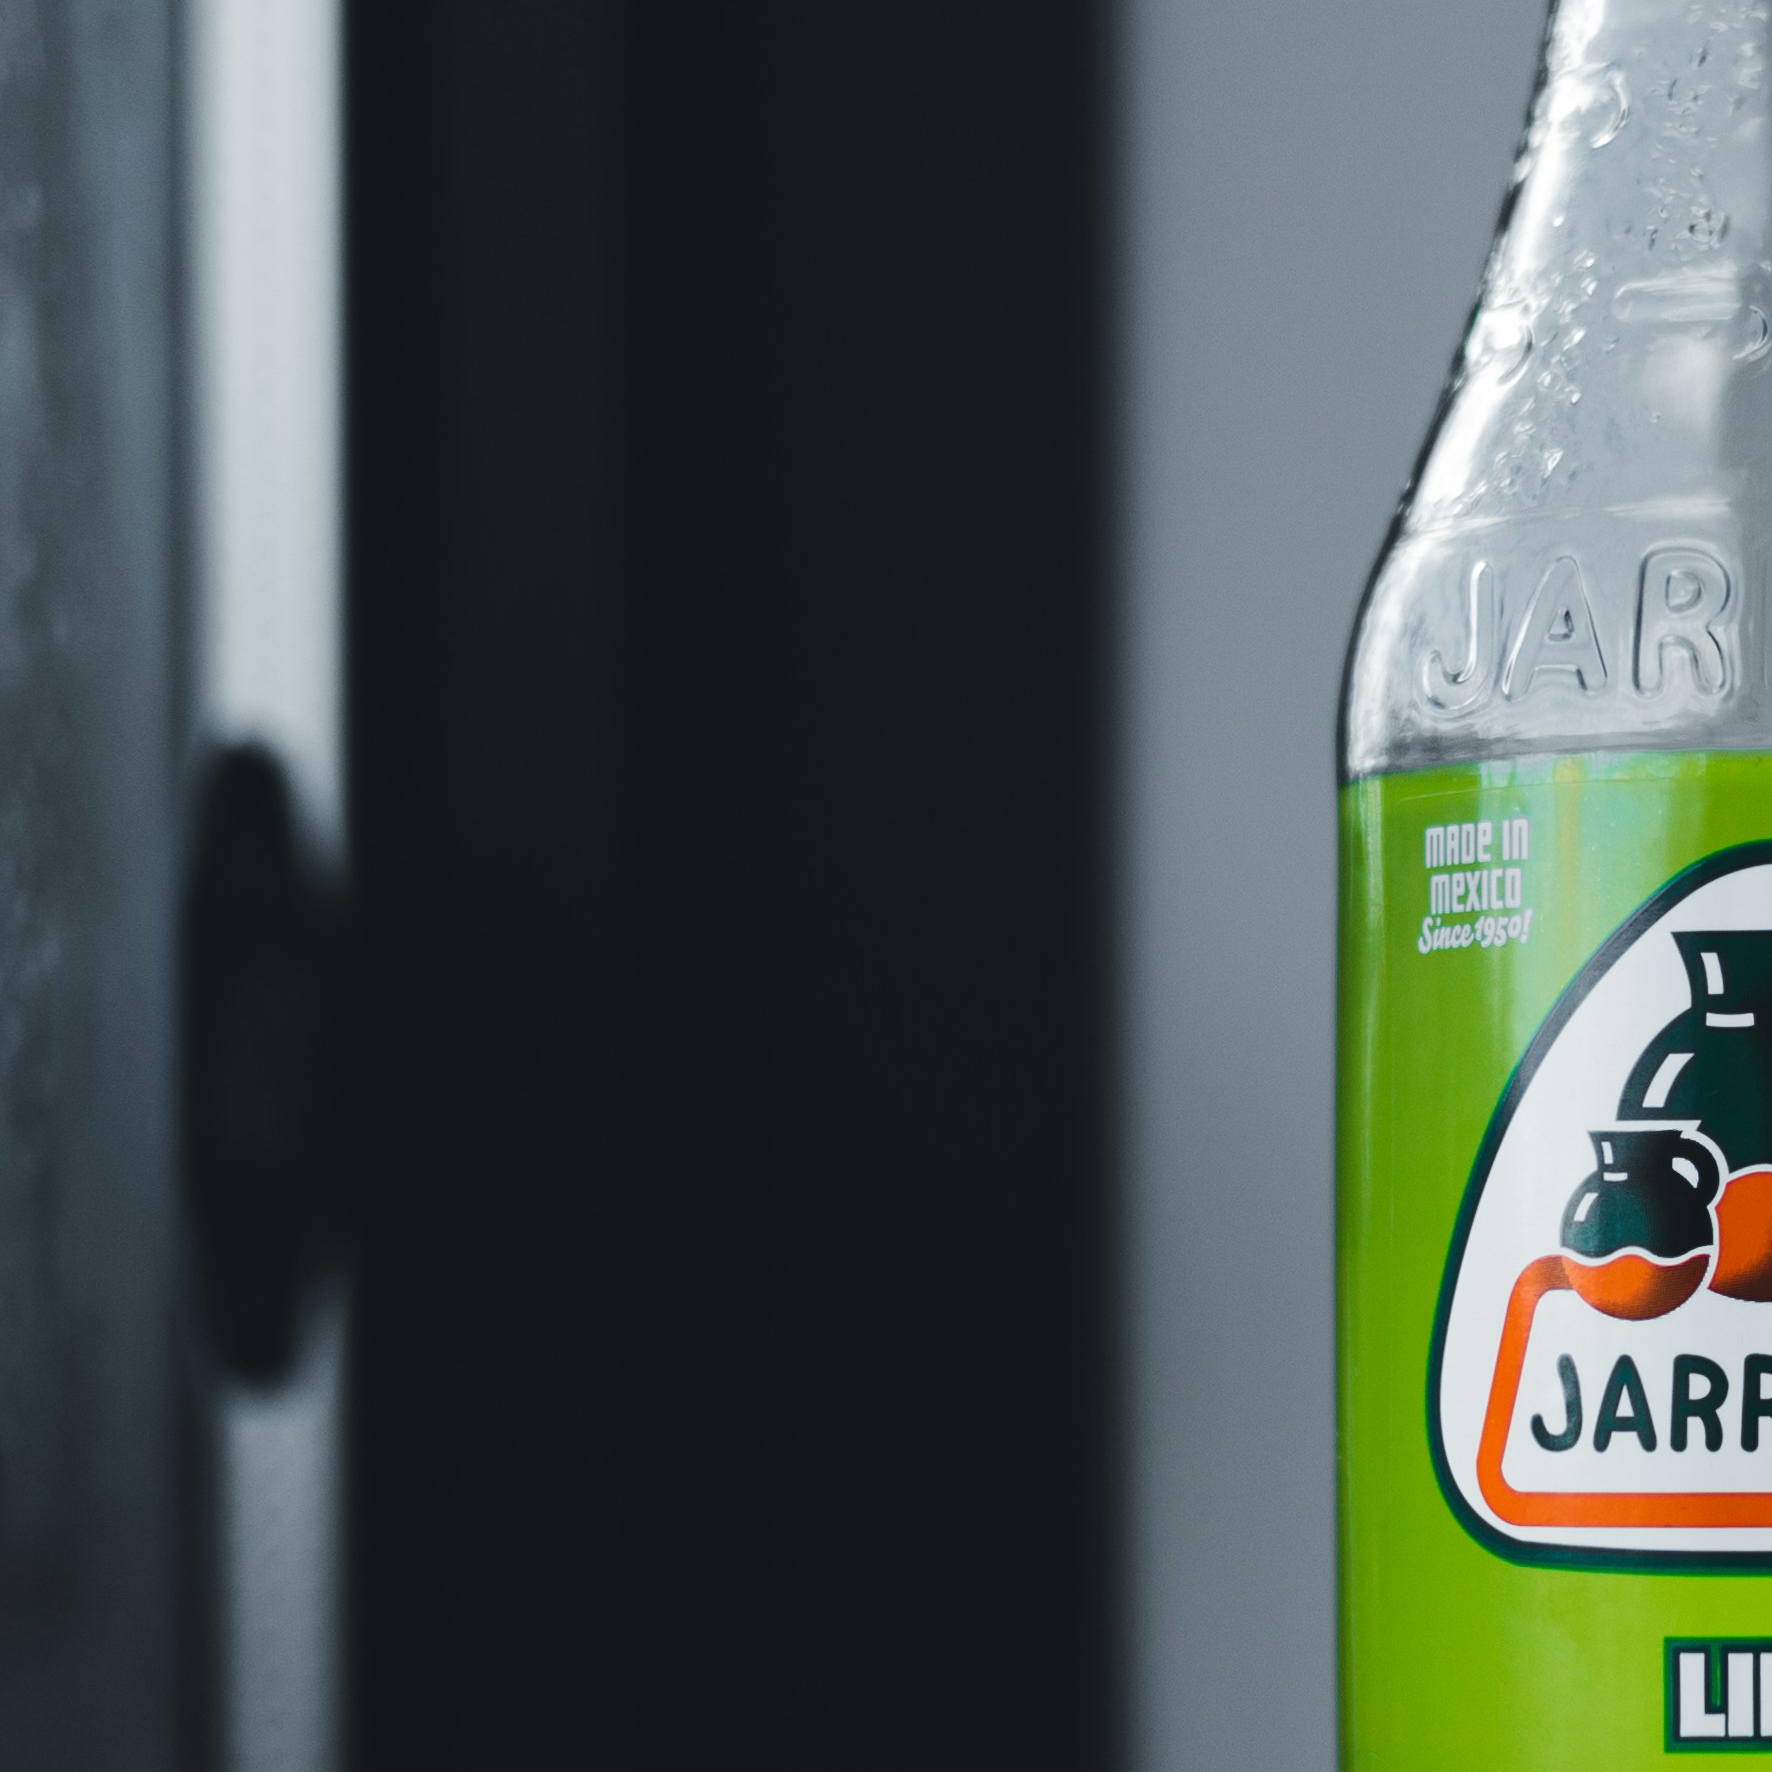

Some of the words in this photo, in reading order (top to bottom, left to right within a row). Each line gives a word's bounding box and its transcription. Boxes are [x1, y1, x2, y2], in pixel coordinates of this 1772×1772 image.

[1502, 818, 1529, 861] IN
[1431, 867, 1522, 916] MEXICO
[1418, 916, 1475, 955] Since
[1474, 907, 1533, 948] 1950!
